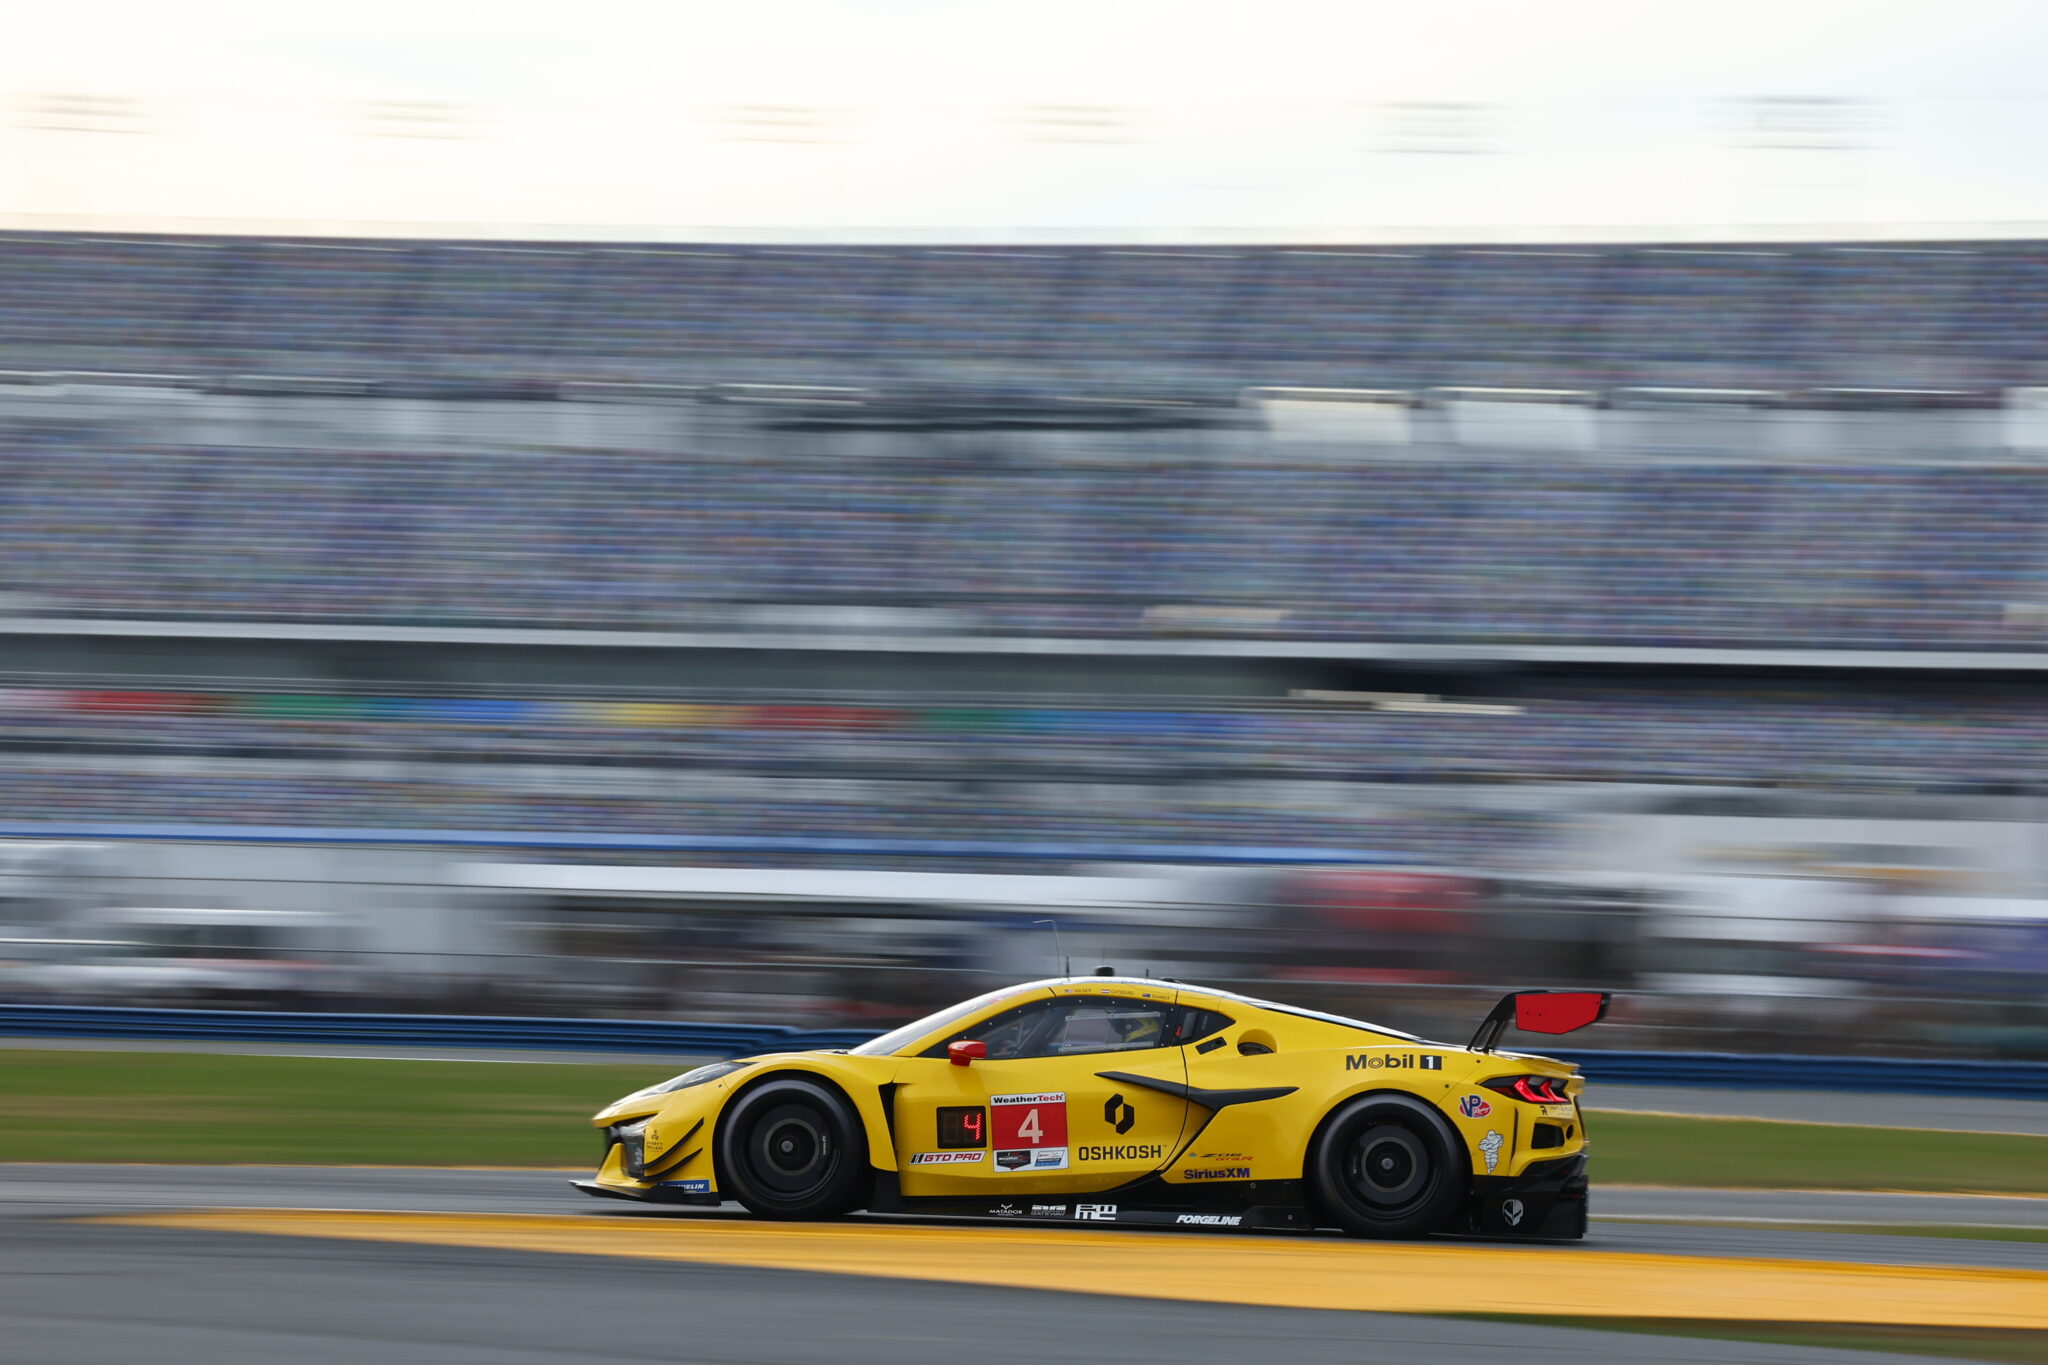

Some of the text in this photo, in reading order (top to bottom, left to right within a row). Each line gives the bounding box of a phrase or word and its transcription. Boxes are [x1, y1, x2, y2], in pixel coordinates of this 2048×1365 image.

[1345, 1054, 1434, 1071] Mobil 1
[993, 1093, 1063, 1104] WeatherTech
[1460, 1094, 1482, 1118] VP
[963, 1112, 982, 1141] 4
[1017, 1108, 1044, 1144] 4
[923, 1152, 983, 1163] GTD PRO
[1078, 1144, 1163, 1161] OSHKOSH
[1183, 1167, 1250, 1180] SiriusXM
[1176, 1214, 1243, 1226] FORGELINE
